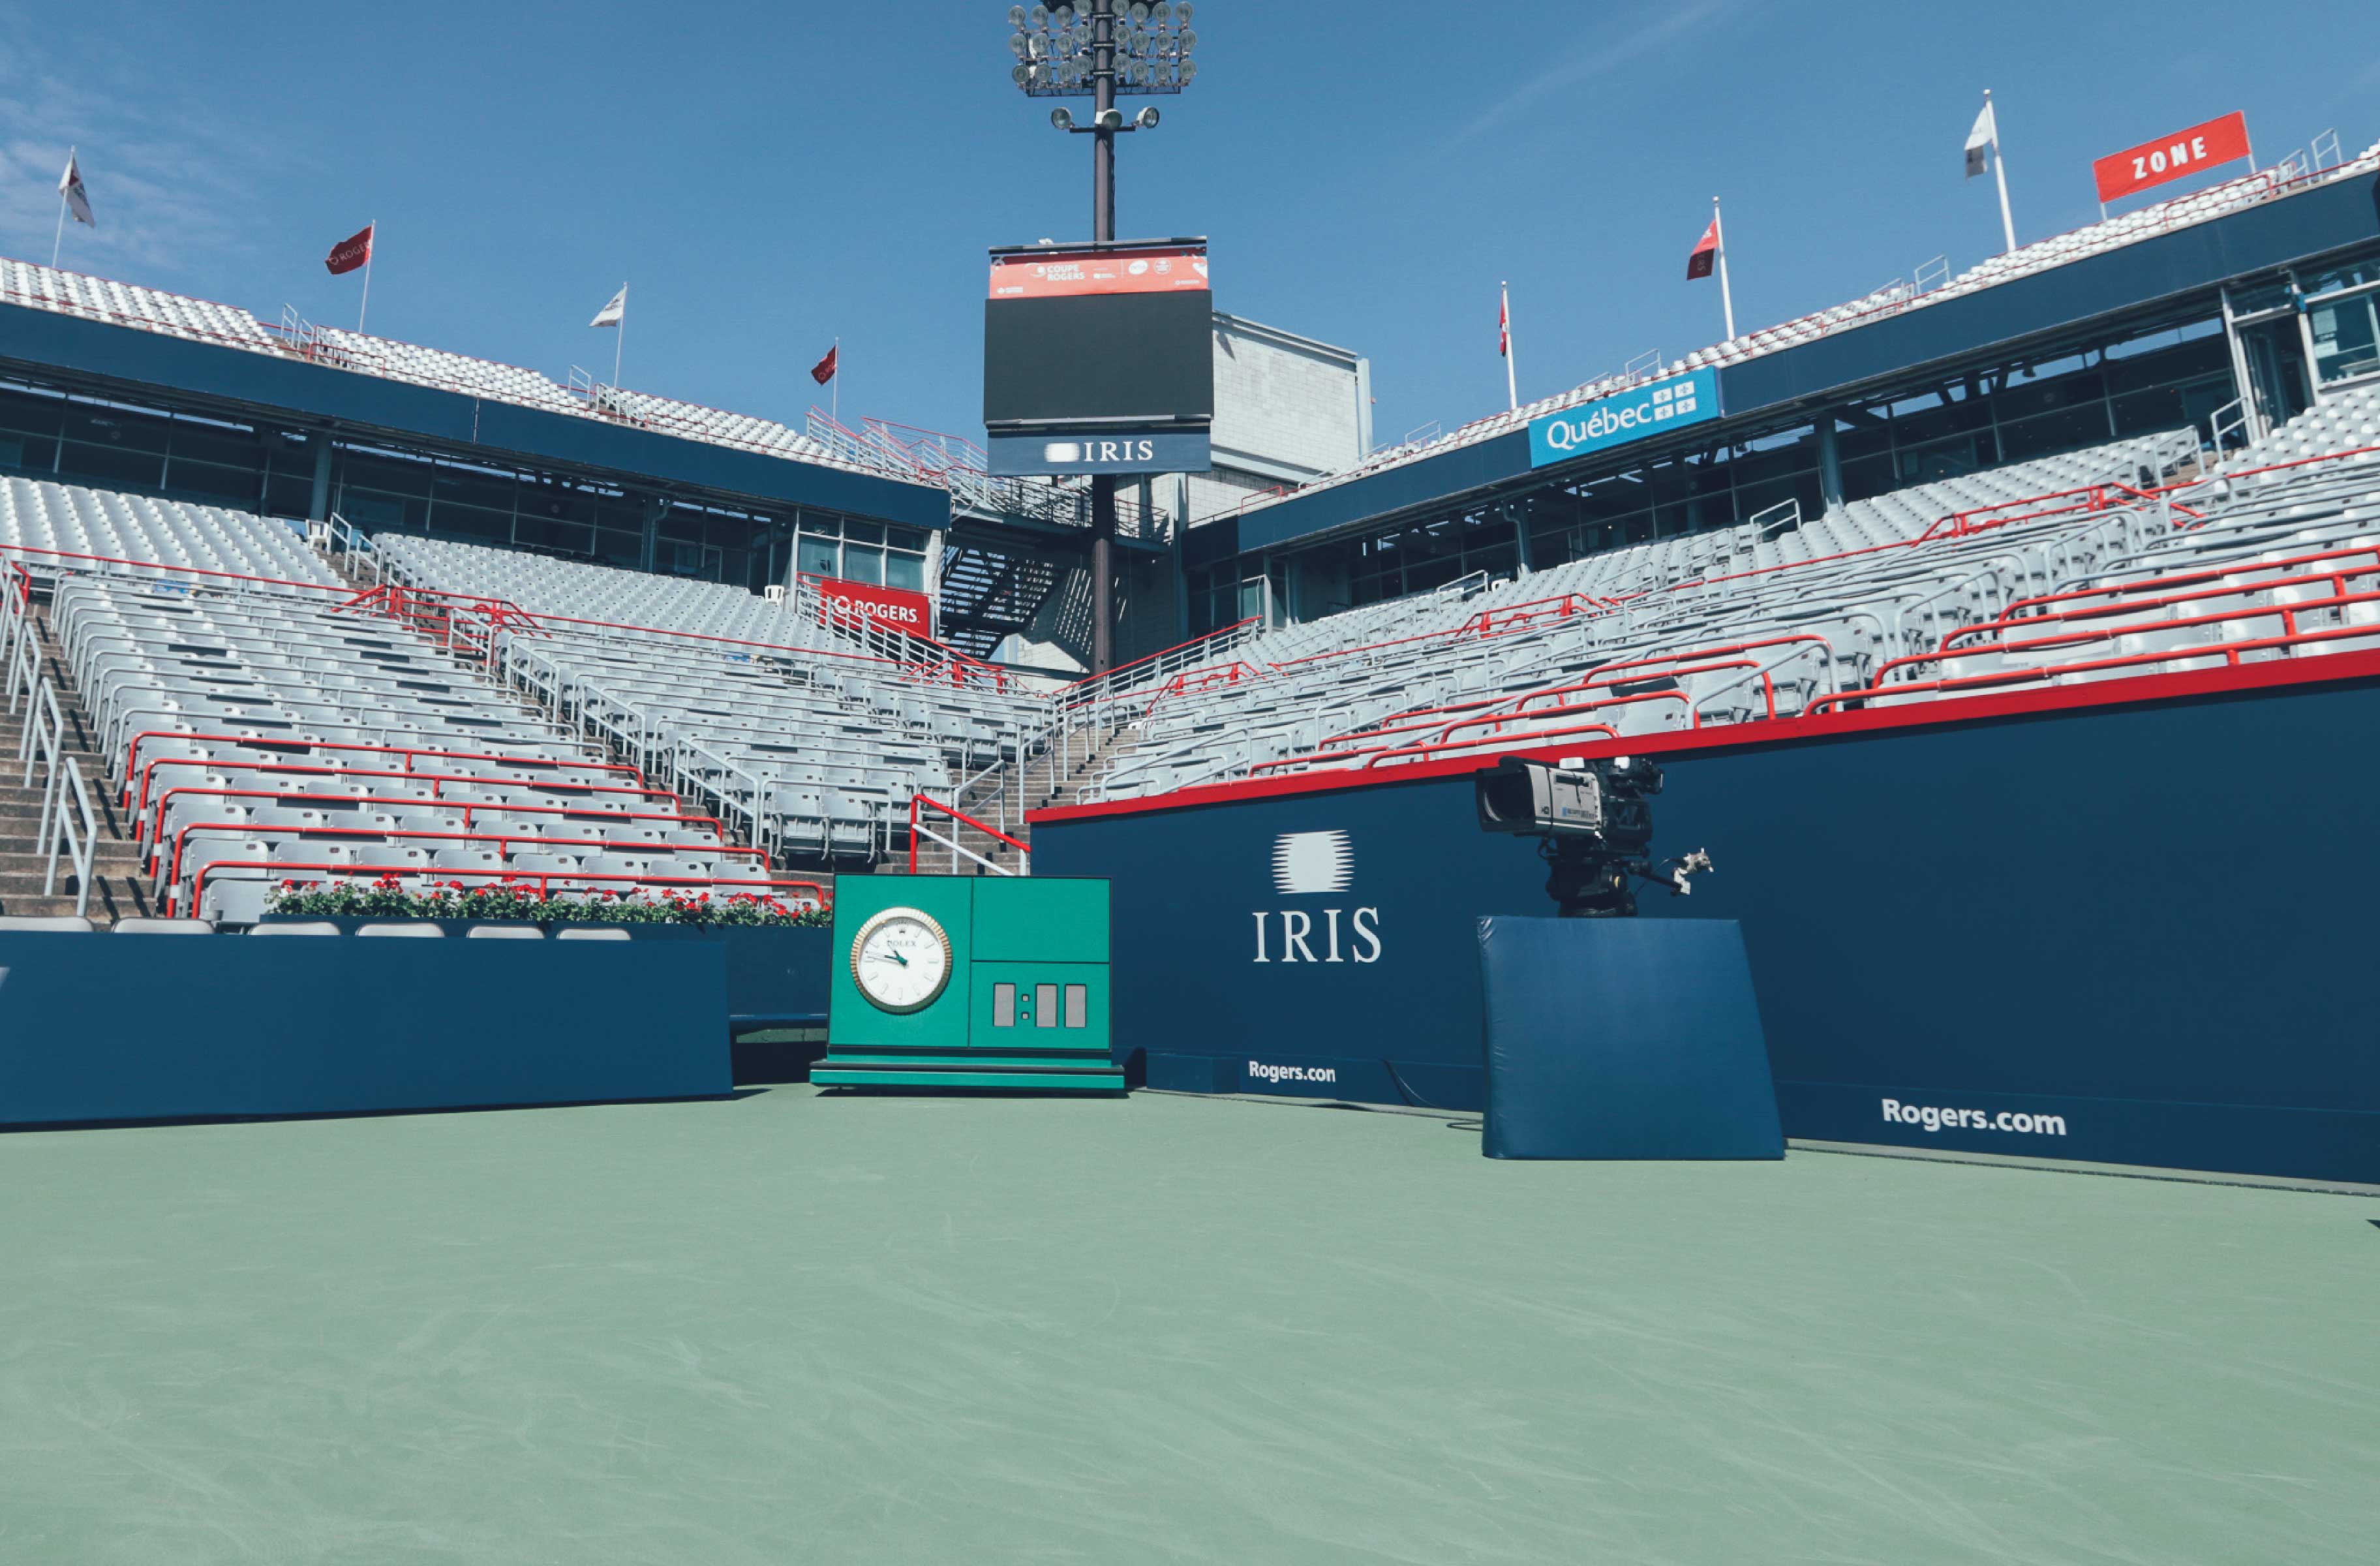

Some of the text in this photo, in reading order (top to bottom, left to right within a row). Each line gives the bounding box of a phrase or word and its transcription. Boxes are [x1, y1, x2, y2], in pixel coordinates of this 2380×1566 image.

[2132, 136, 2207, 179] ZONE
[1047, 272, 1085, 281] ROGERS
[1547, 403, 1652, 450] Québec
[1084, 440, 1153, 462] IRIS
[854, 600, 917, 622] ROGERS
[1252, 907, 1382, 963] IRIS
[1882, 1099, 2067, 1135] Rogers.com
